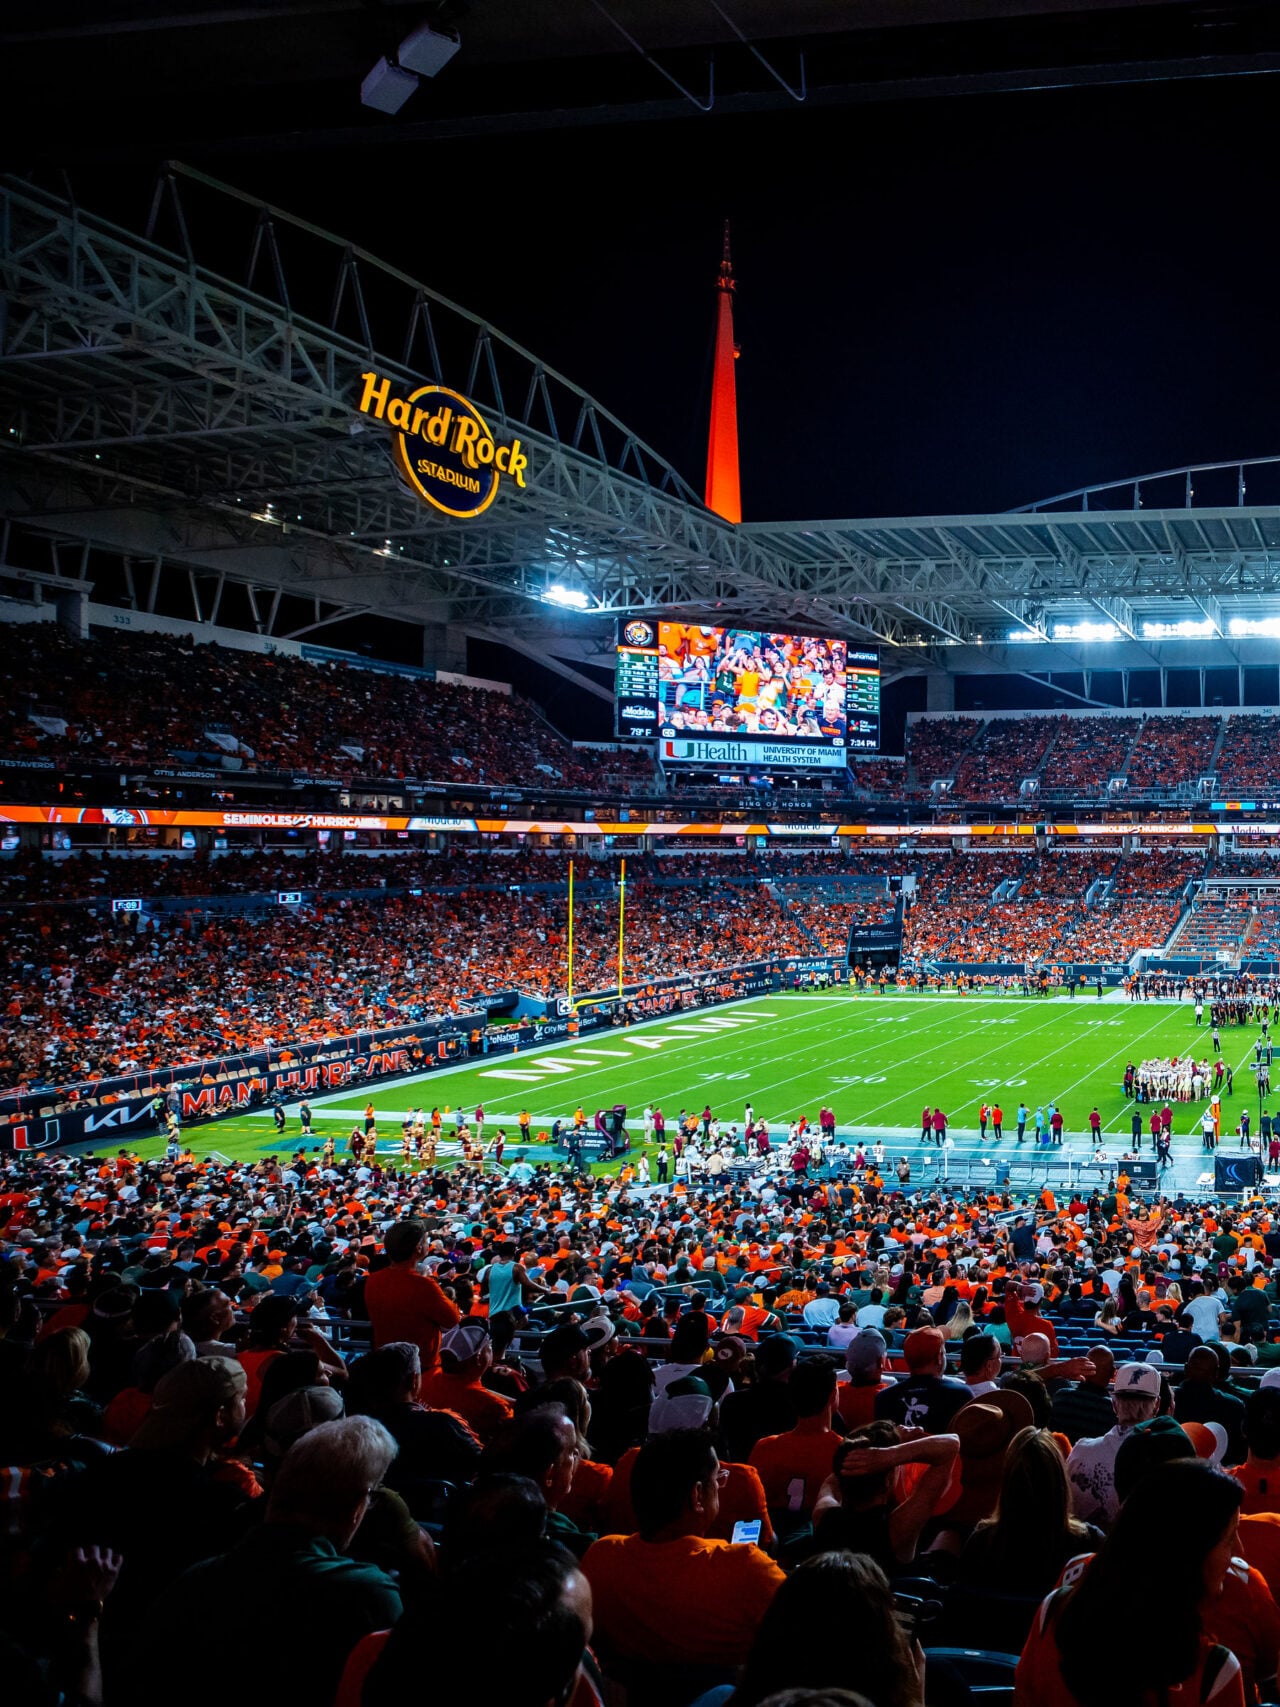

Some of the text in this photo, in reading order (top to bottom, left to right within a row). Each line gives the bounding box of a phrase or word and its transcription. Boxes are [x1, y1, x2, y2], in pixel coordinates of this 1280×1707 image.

[360, 372, 528, 488] Hard Rock
[418, 459, 480, 493] STADIUM
[113, 615, 131, 625] 333
[763, 746, 807, 755] UNIVERSITY
[818, 748, 842, 756] MIAMI
[763, 755, 821, 764] HEALTH SYSTEM
[153, 770, 216, 779] OTTIS ANDERSON
[223, 813, 292, 826] SEMINOLES
[559, 999, 573, 1013] 25
[544, 1024, 557, 1035] City
[13, 1118, 60, 1151] U
[787, 1477, 806, 1512] 1
